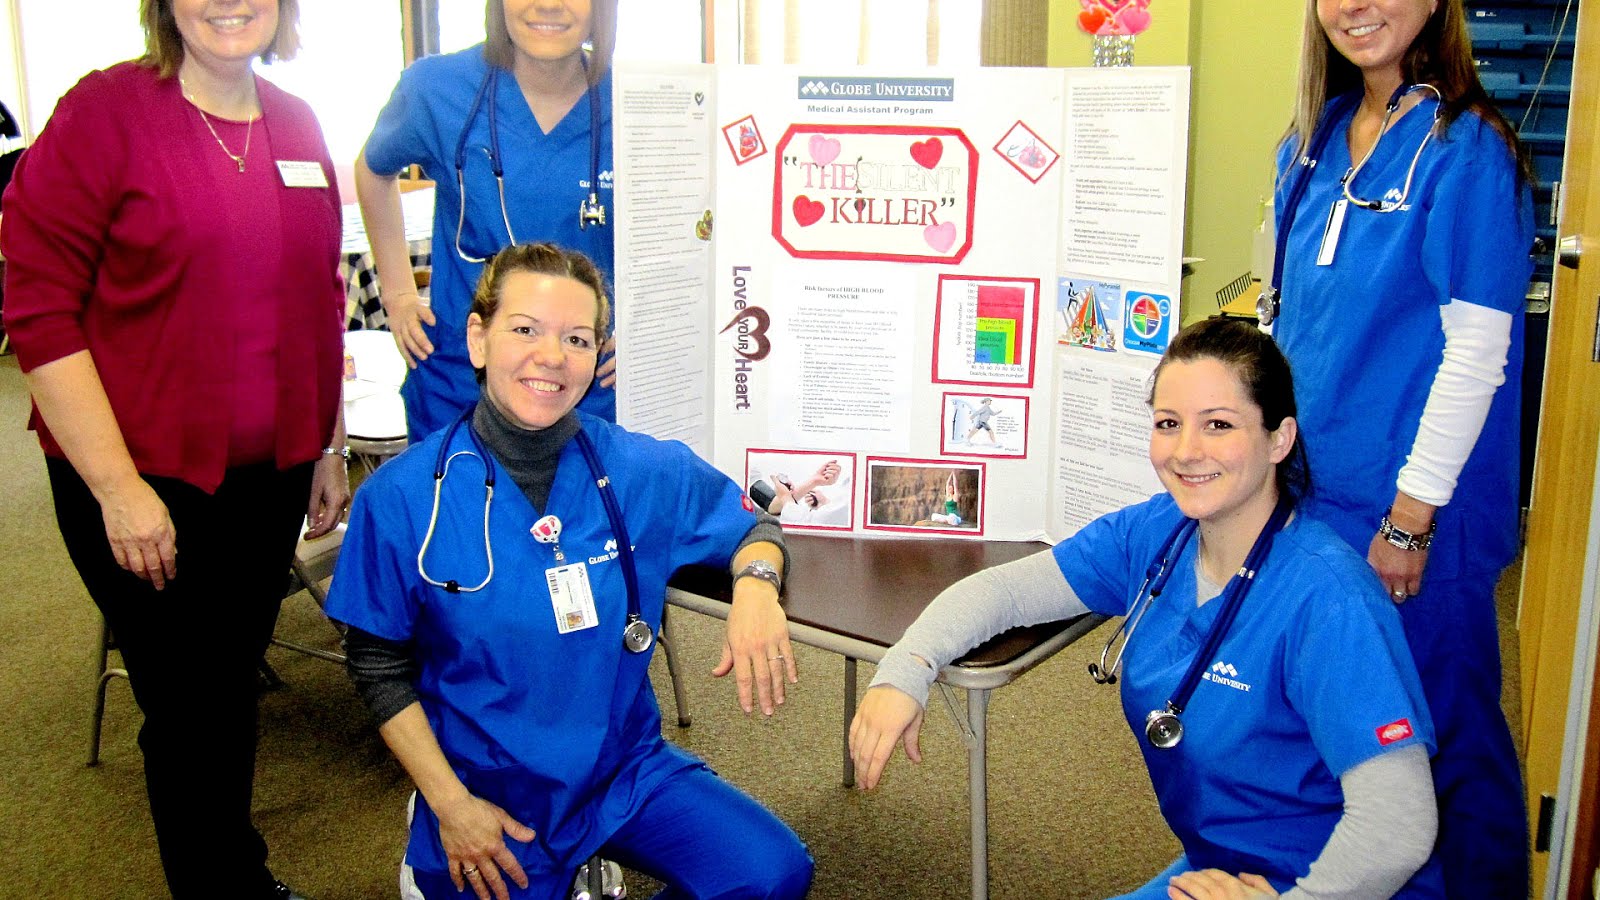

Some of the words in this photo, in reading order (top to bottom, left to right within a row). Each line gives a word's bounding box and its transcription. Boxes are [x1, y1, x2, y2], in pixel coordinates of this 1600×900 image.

[831, 82, 871, 96] GLOBE
[876, 83, 952, 97] UNIVERSITY
[807, 104, 844, 114] Medical
[847, 105, 891, 114] Assistant
[893, 106, 934, 116] Program
[732, 265, 752, 311] Love
[734, 359, 752, 411] Heart
